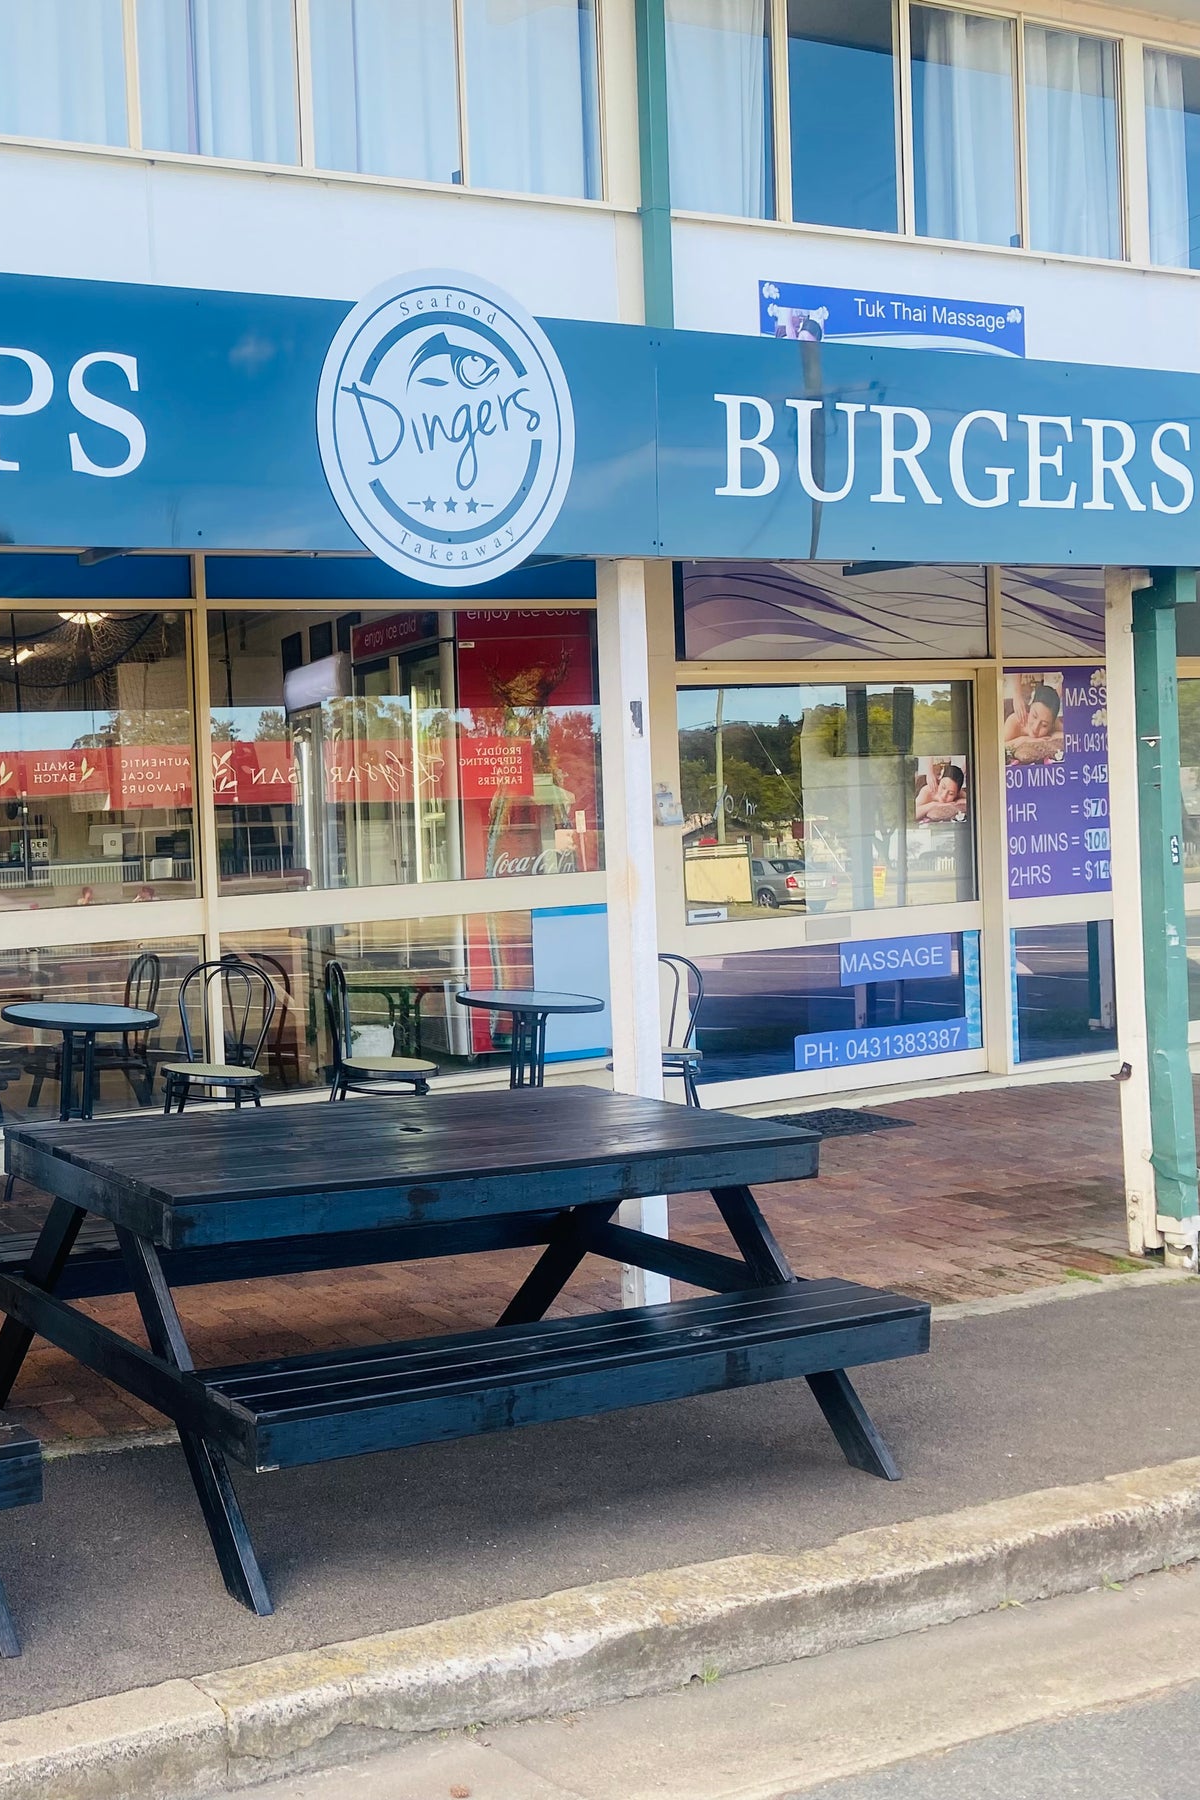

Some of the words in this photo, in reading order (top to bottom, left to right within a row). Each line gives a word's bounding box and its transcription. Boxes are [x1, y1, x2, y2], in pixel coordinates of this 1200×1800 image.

[400, 293, 497, 325] Seafood
[854, 298, 886, 318] Tuk
[890, 302, 927, 322] Thai
[932, 306, 1006, 333] Massage
[340, 381, 541, 491] Dingers
[714, 393, 1195, 515] BURGERS
[398, 525, 516, 562] Takeaway
[364, 629, 384, 648] enjoy
[399, 615, 417, 636] cold
[1065, 687, 1107, 707] MASS
[1065, 736, 1082, 753] PH:
[1084, 733, 1109, 752] 04313
[1006, 769, 1023, 789] 30
[1027, 767, 1066, 788] MINS
[1082, 764, 1108, 785] $45
[1007, 803, 1038, 823] 1HR
[1009, 836, 1027, 855] 90
[1031, 832, 1069, 854] MINS
[1010, 864, 1052, 887] 2HRS
[1085, 859, 1112, 883] $14
[840, 946, 944, 975] MASSAGE
[804, 1041, 839, 1065] PH:
[846, 1027, 961, 1060] 0431383387
